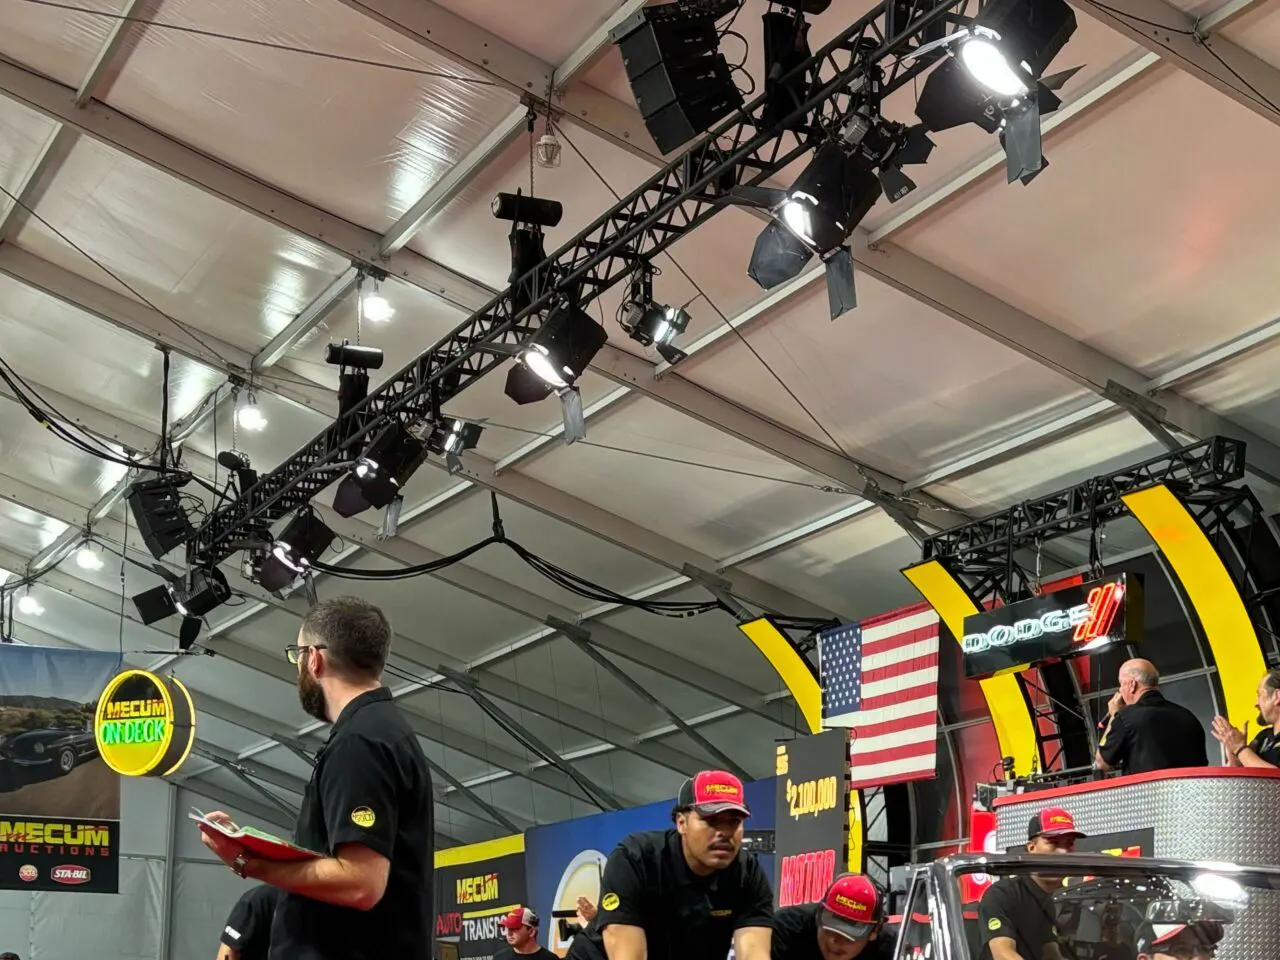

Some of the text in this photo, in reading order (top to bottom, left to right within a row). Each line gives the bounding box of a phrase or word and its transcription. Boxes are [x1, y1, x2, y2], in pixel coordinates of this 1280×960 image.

[960, 603, 1093, 654] DODGE
[107, 699, 165, 718] MECUM
[100, 719, 165, 744] ON DECK
[0, 821, 109, 846] MECUM
[53, 869, 88, 880] STA-BIL
[456, 873, 499, 904] MECUM
[436, 911, 462, 935] AUTO
